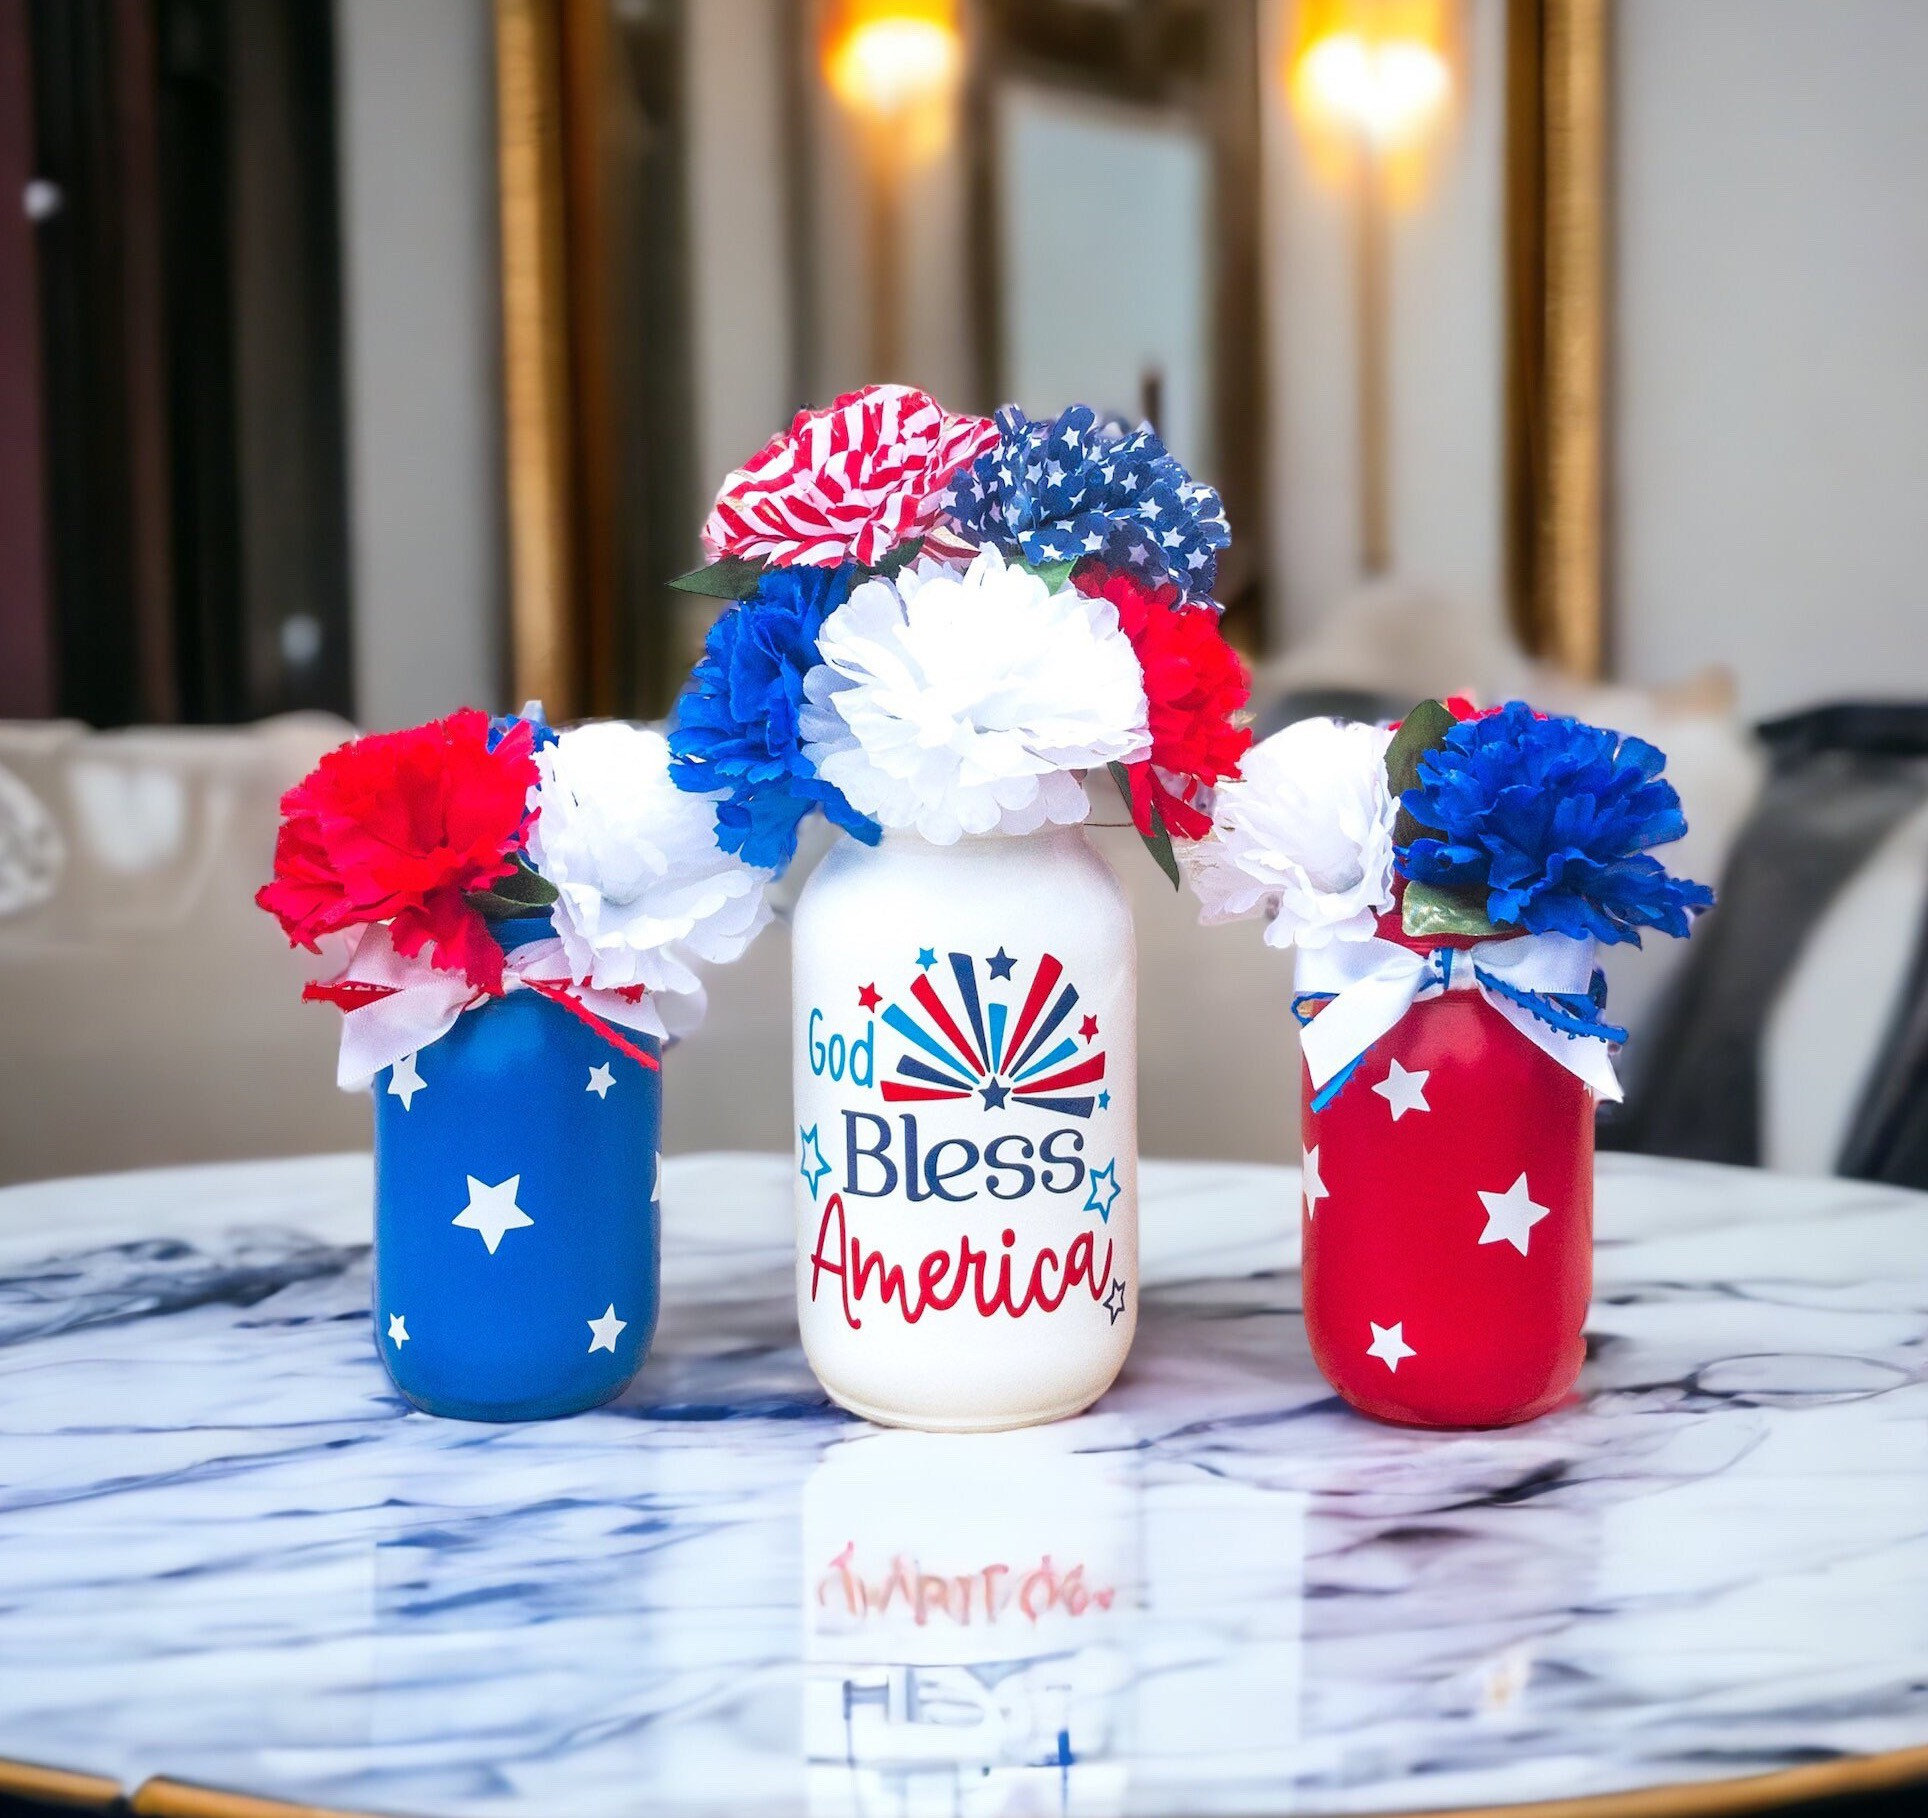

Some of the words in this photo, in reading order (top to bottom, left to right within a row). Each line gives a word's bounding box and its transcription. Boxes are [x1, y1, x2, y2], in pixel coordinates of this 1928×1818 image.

[809, 1008, 874, 1089] God
[841, 1109, 1086, 1202] Bless
[811, 1192, 1113, 1330] America
